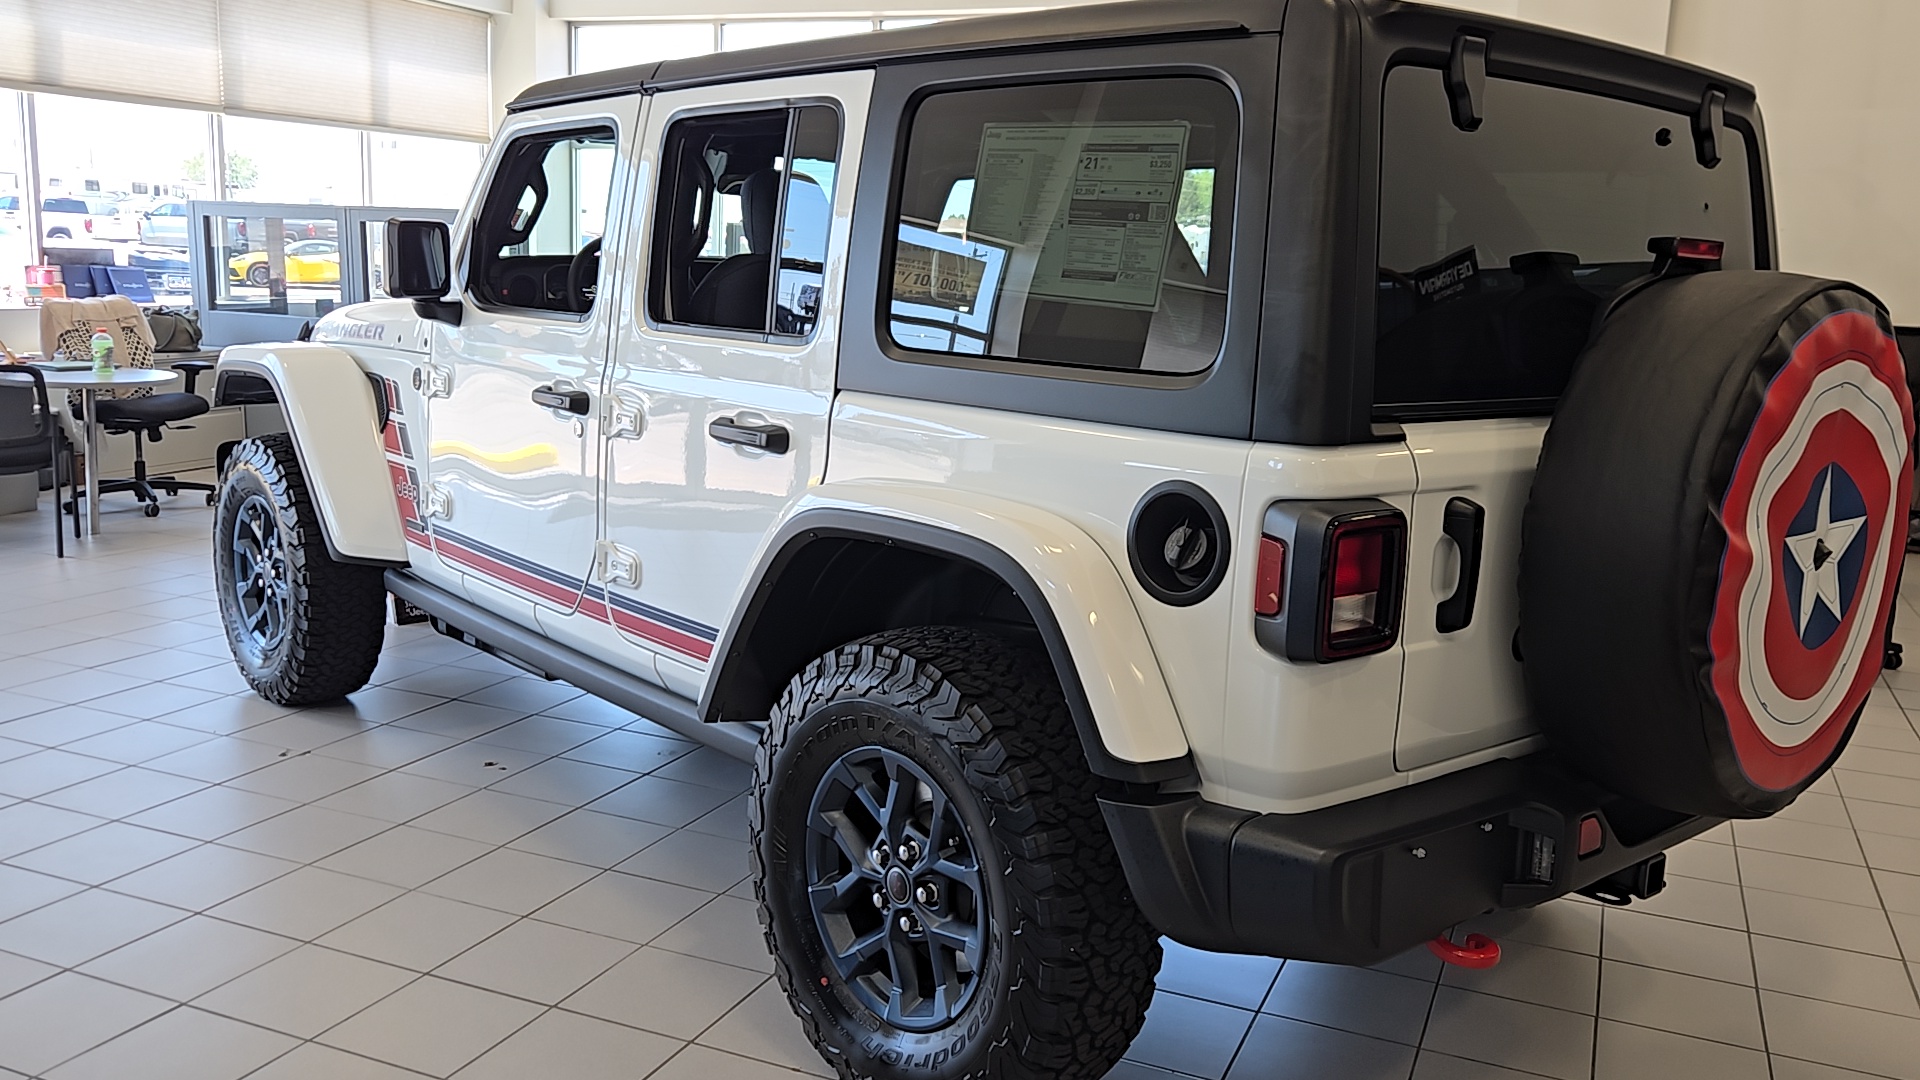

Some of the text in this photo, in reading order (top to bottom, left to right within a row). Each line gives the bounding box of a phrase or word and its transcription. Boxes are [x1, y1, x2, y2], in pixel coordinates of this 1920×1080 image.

[1084, 157, 1099, 170] 21
[1149, 160, 1172, 169] $3,250
[396, 475, 418, 503] Jeep
